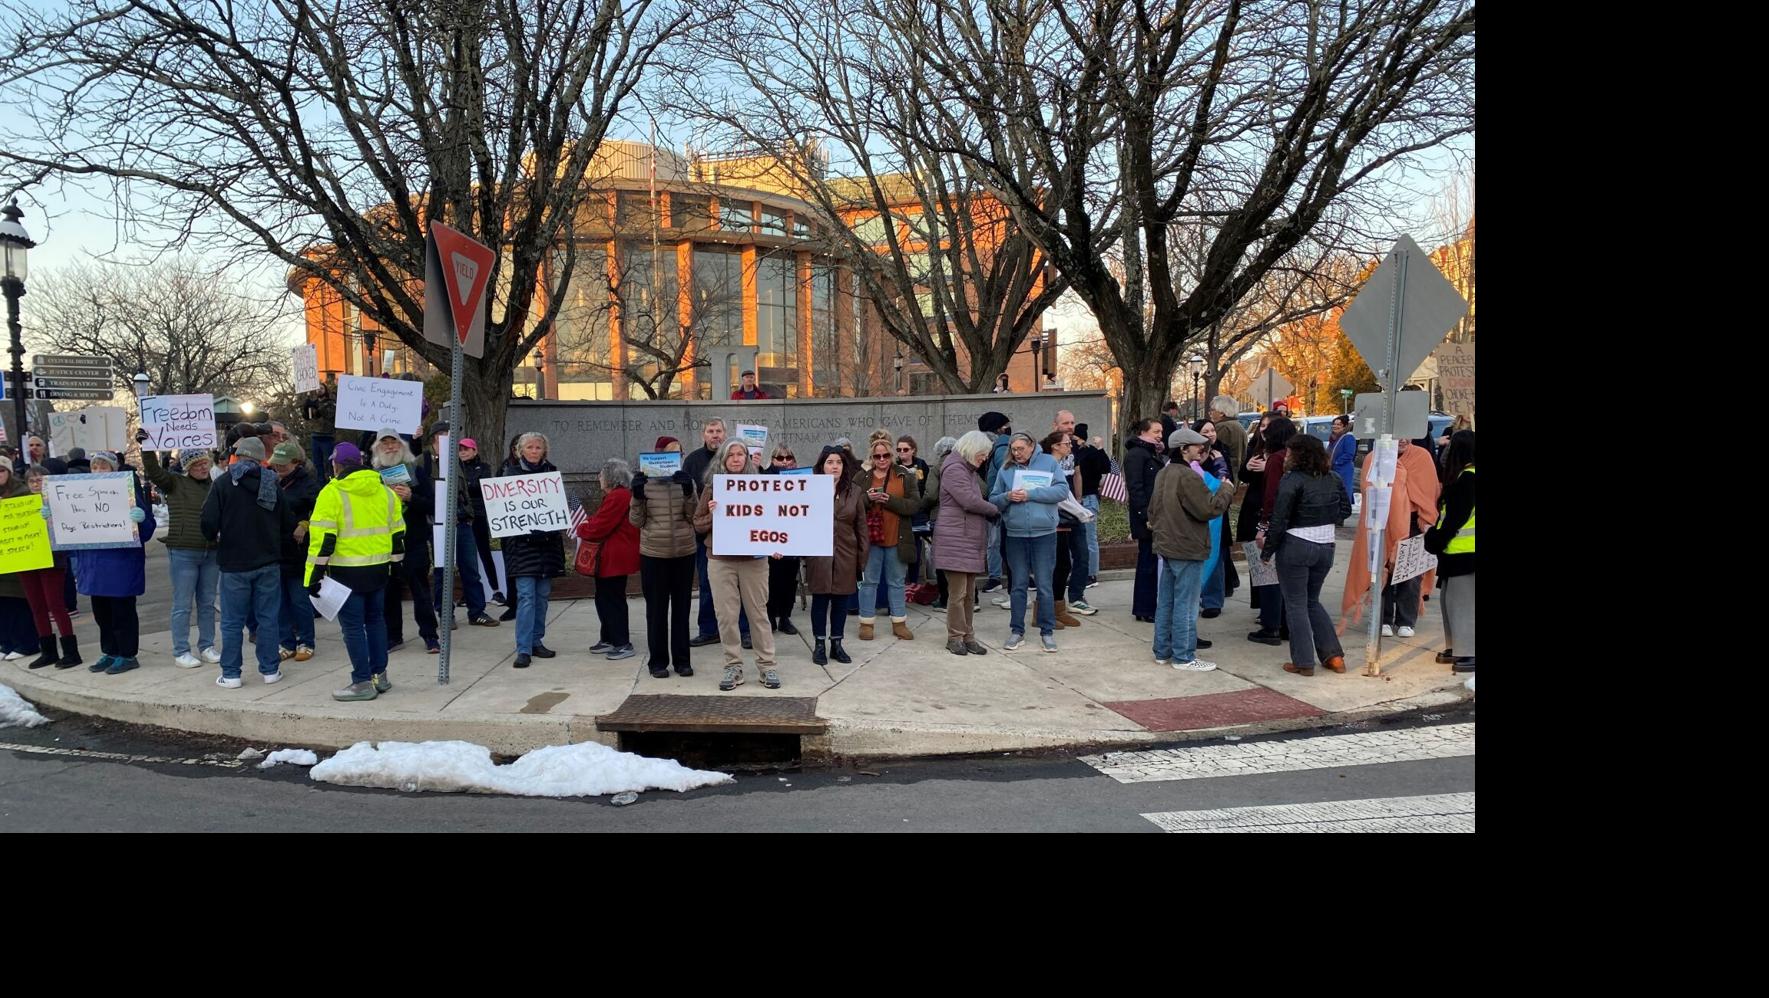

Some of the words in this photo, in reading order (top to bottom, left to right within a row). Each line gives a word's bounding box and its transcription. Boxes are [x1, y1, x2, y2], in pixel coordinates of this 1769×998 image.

[456, 260, 474, 280] YIELD
[371, 382, 415, 398] Engagement
[140, 397, 212, 423] Freedom
[166, 420, 198, 432] Needs
[552, 420, 569, 432] TO
[577, 420, 642, 432] REMEMBER
[650, 420, 675, 431] AND
[774, 418, 840, 429] AMERICANS
[848, 416, 874, 427] WHO
[882, 416, 912, 426] GAVE
[918, 415, 933, 426] OF
[147, 426, 213, 449] Voices
[768, 432, 818, 442] VIETNAM
[56, 485, 84, 501] Free
[482, 477, 560, 500] DIVERSITY
[726, 479, 807, 491] PROTECT
[95, 502, 110, 512] NO
[504, 501, 516, 512] IS
[521, 498, 548, 510] OUR
[726, 504, 764, 516] KIDS
[778, 504, 809, 516] NOT
[491, 510, 568, 531] STRENGTH
[750, 530, 788, 543] EGOS
